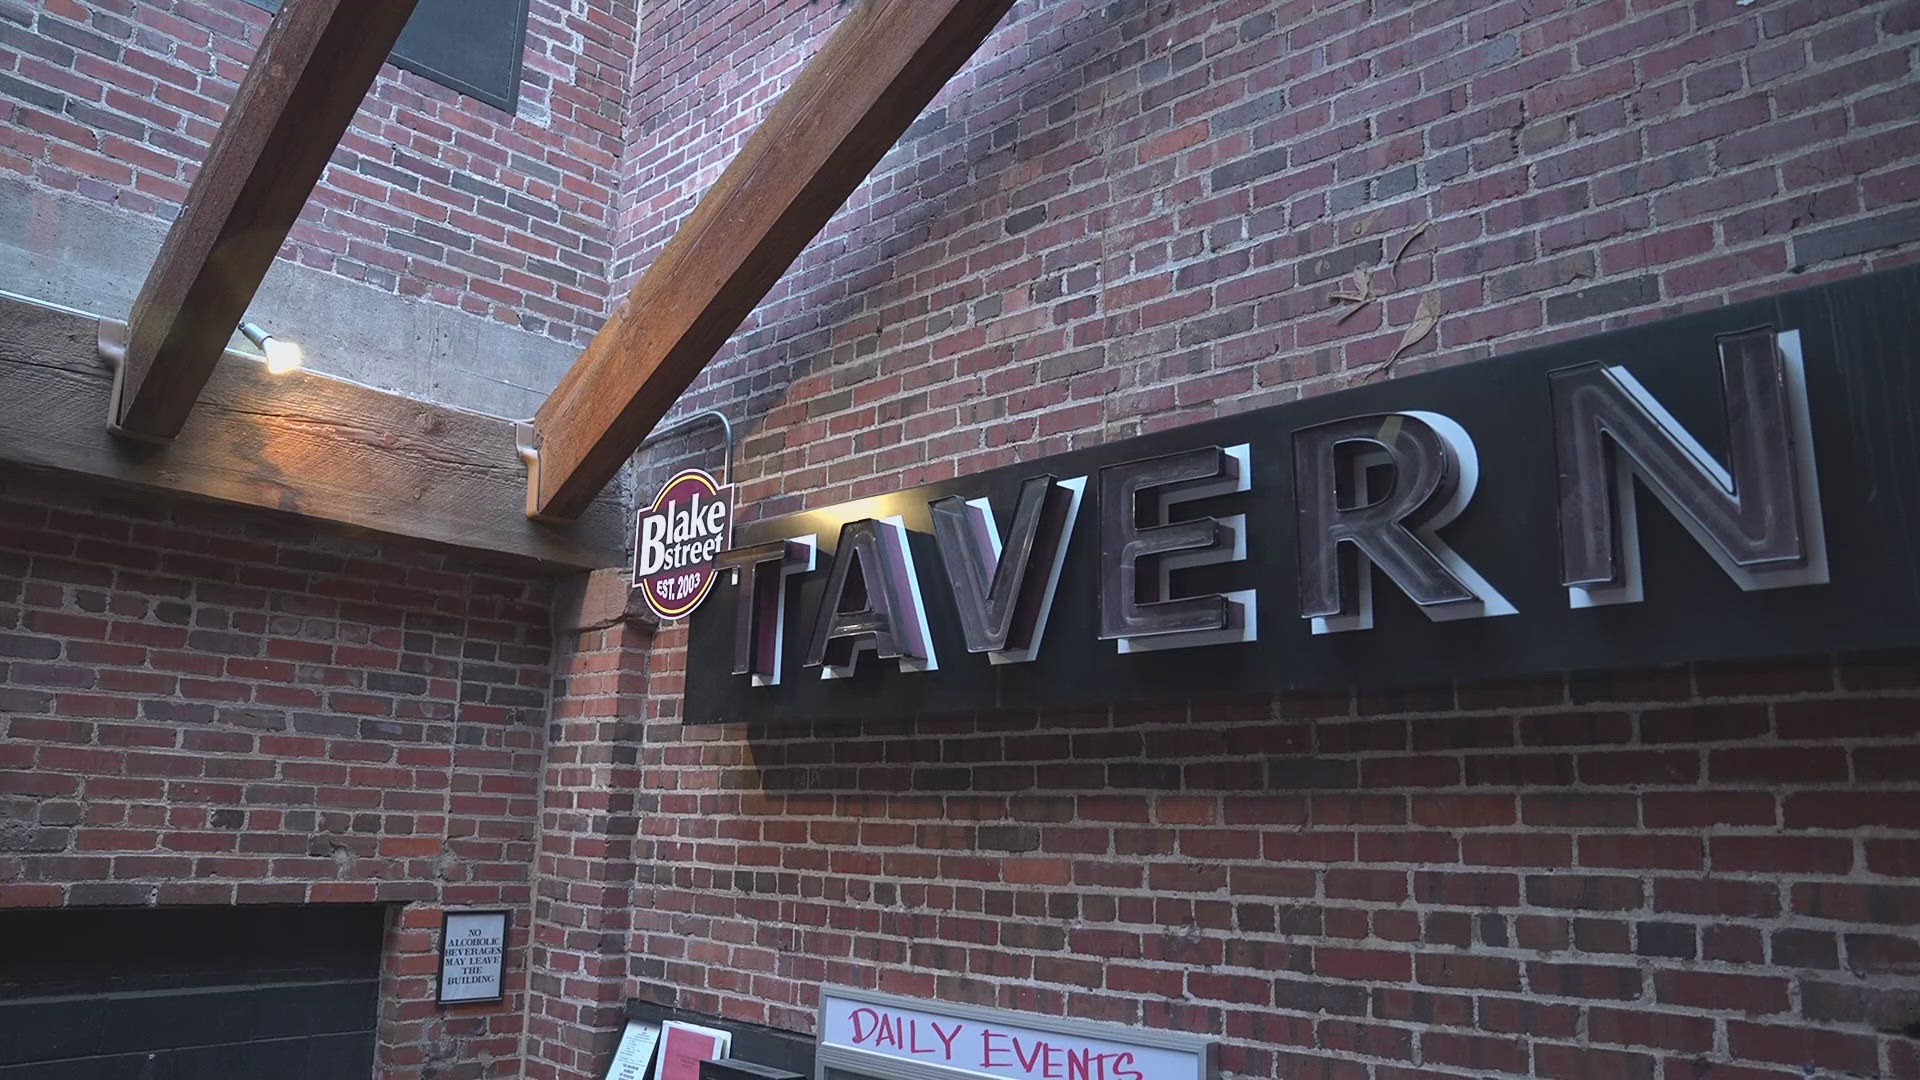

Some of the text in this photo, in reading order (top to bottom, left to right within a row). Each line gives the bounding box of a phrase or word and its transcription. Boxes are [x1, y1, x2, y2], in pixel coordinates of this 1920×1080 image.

[714, 328, 1830, 686] TAVERN
[640, 493, 726, 576] Blake
[664, 533, 723, 570] street
[657, 572, 701, 600] EST. 2003
[445, 947, 502, 956] BEVERAGES
[448, 938, 500, 947] ALCOHOLIC
[446, 957, 500, 966] MAY LEAVE
[462, 966, 483, 975] THE
[448, 975, 494, 985] BUILDING
[848, 1007, 1143, 1080] DAILY EVENTS
